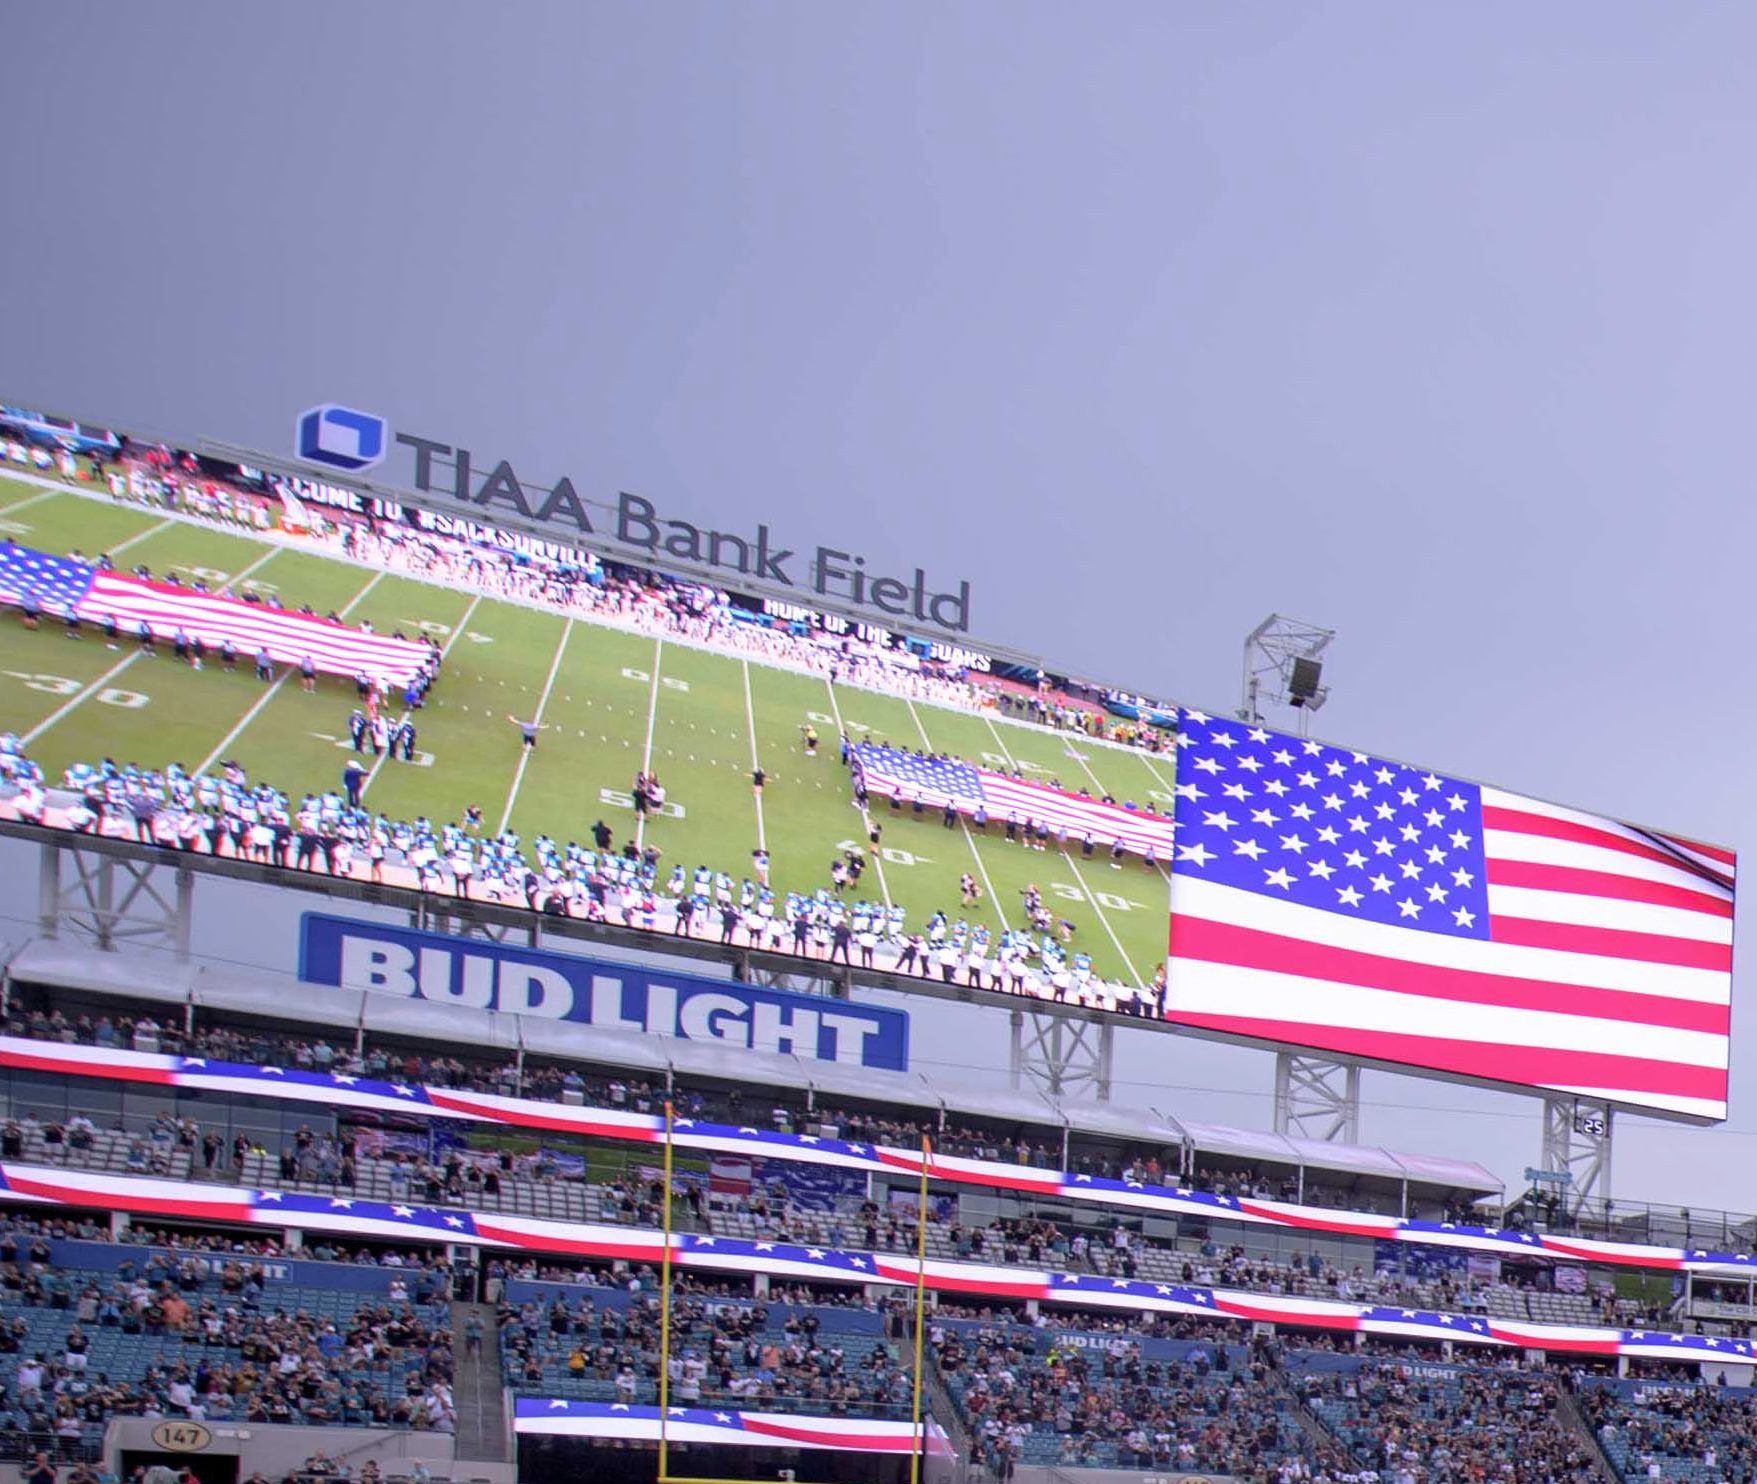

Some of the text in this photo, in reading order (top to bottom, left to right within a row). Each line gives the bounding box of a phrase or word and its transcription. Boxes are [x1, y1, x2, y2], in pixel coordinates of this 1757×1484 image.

[396, 432, 970, 632] TIAA Bank Field
[341, 934, 879, 1066] BUD LIGHT
[1584, 1118, 1604, 1135] 25
[162, 1428, 199, 1444] 147
